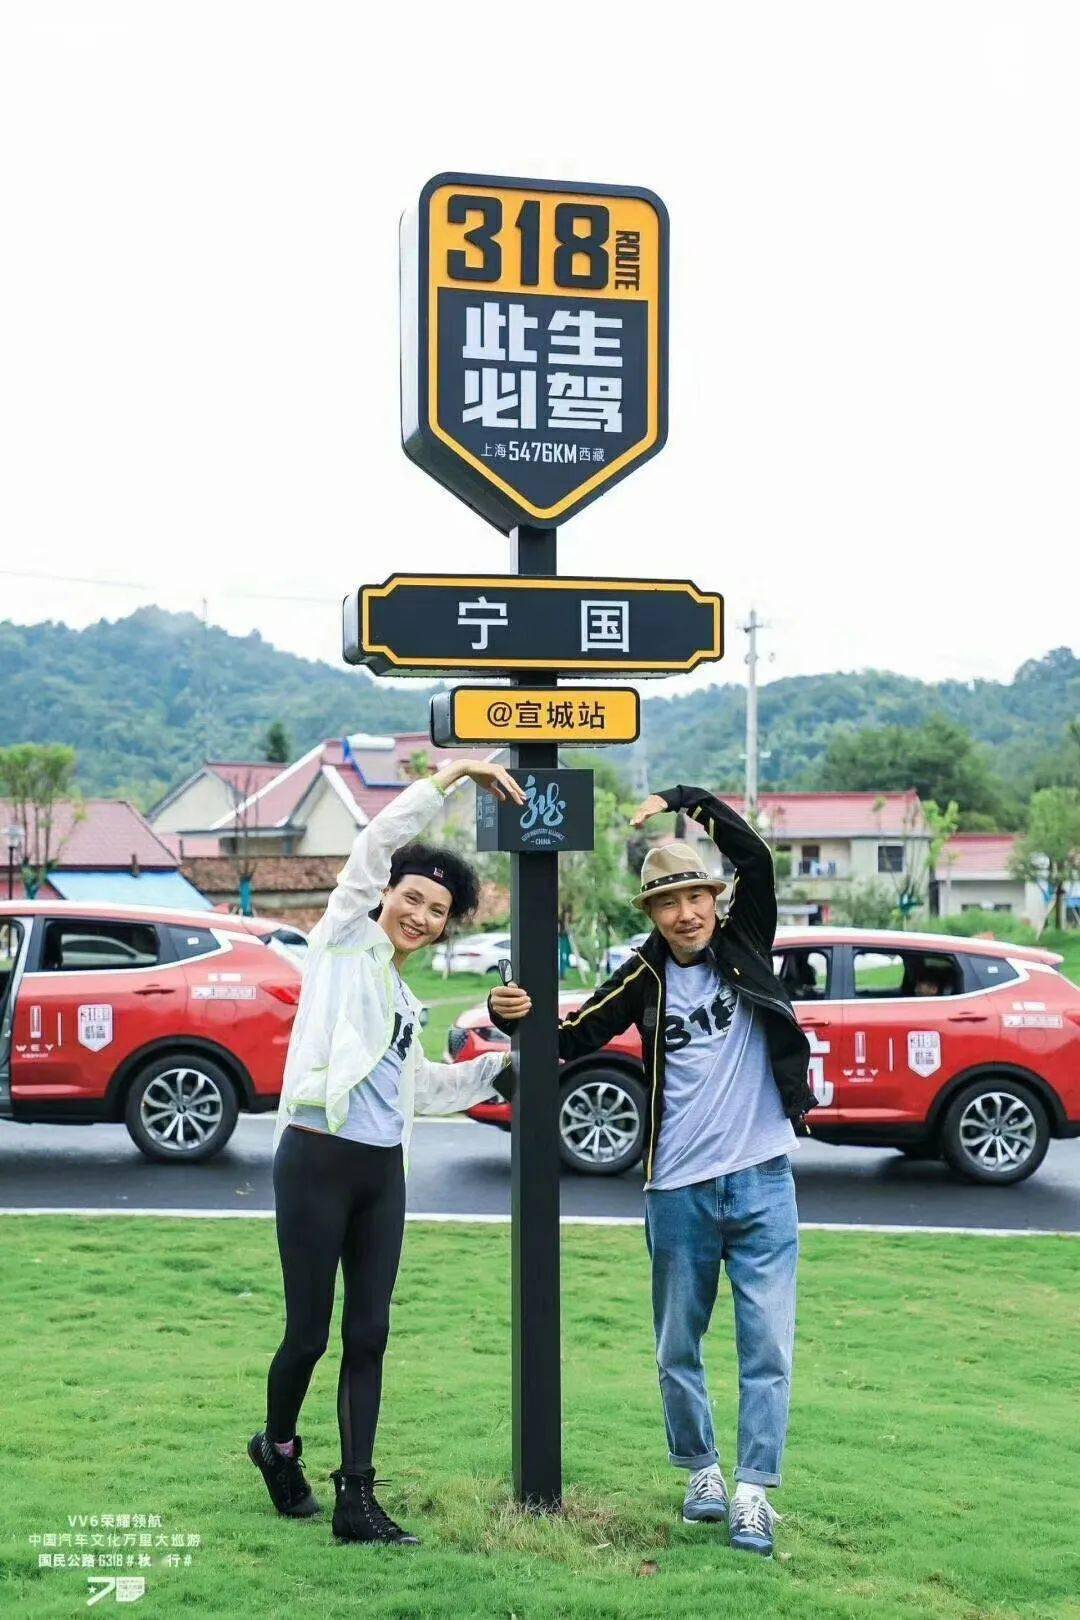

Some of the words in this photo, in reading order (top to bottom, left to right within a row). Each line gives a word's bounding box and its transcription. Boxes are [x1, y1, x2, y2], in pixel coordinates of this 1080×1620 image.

[447, 193, 610, 291] 318
[615, 230, 640, 291] ROUTE
[462, 301, 623, 368] 此生
[462, 368, 623, 433] 必驾
[487, 700, 606, 730] @宣城站
